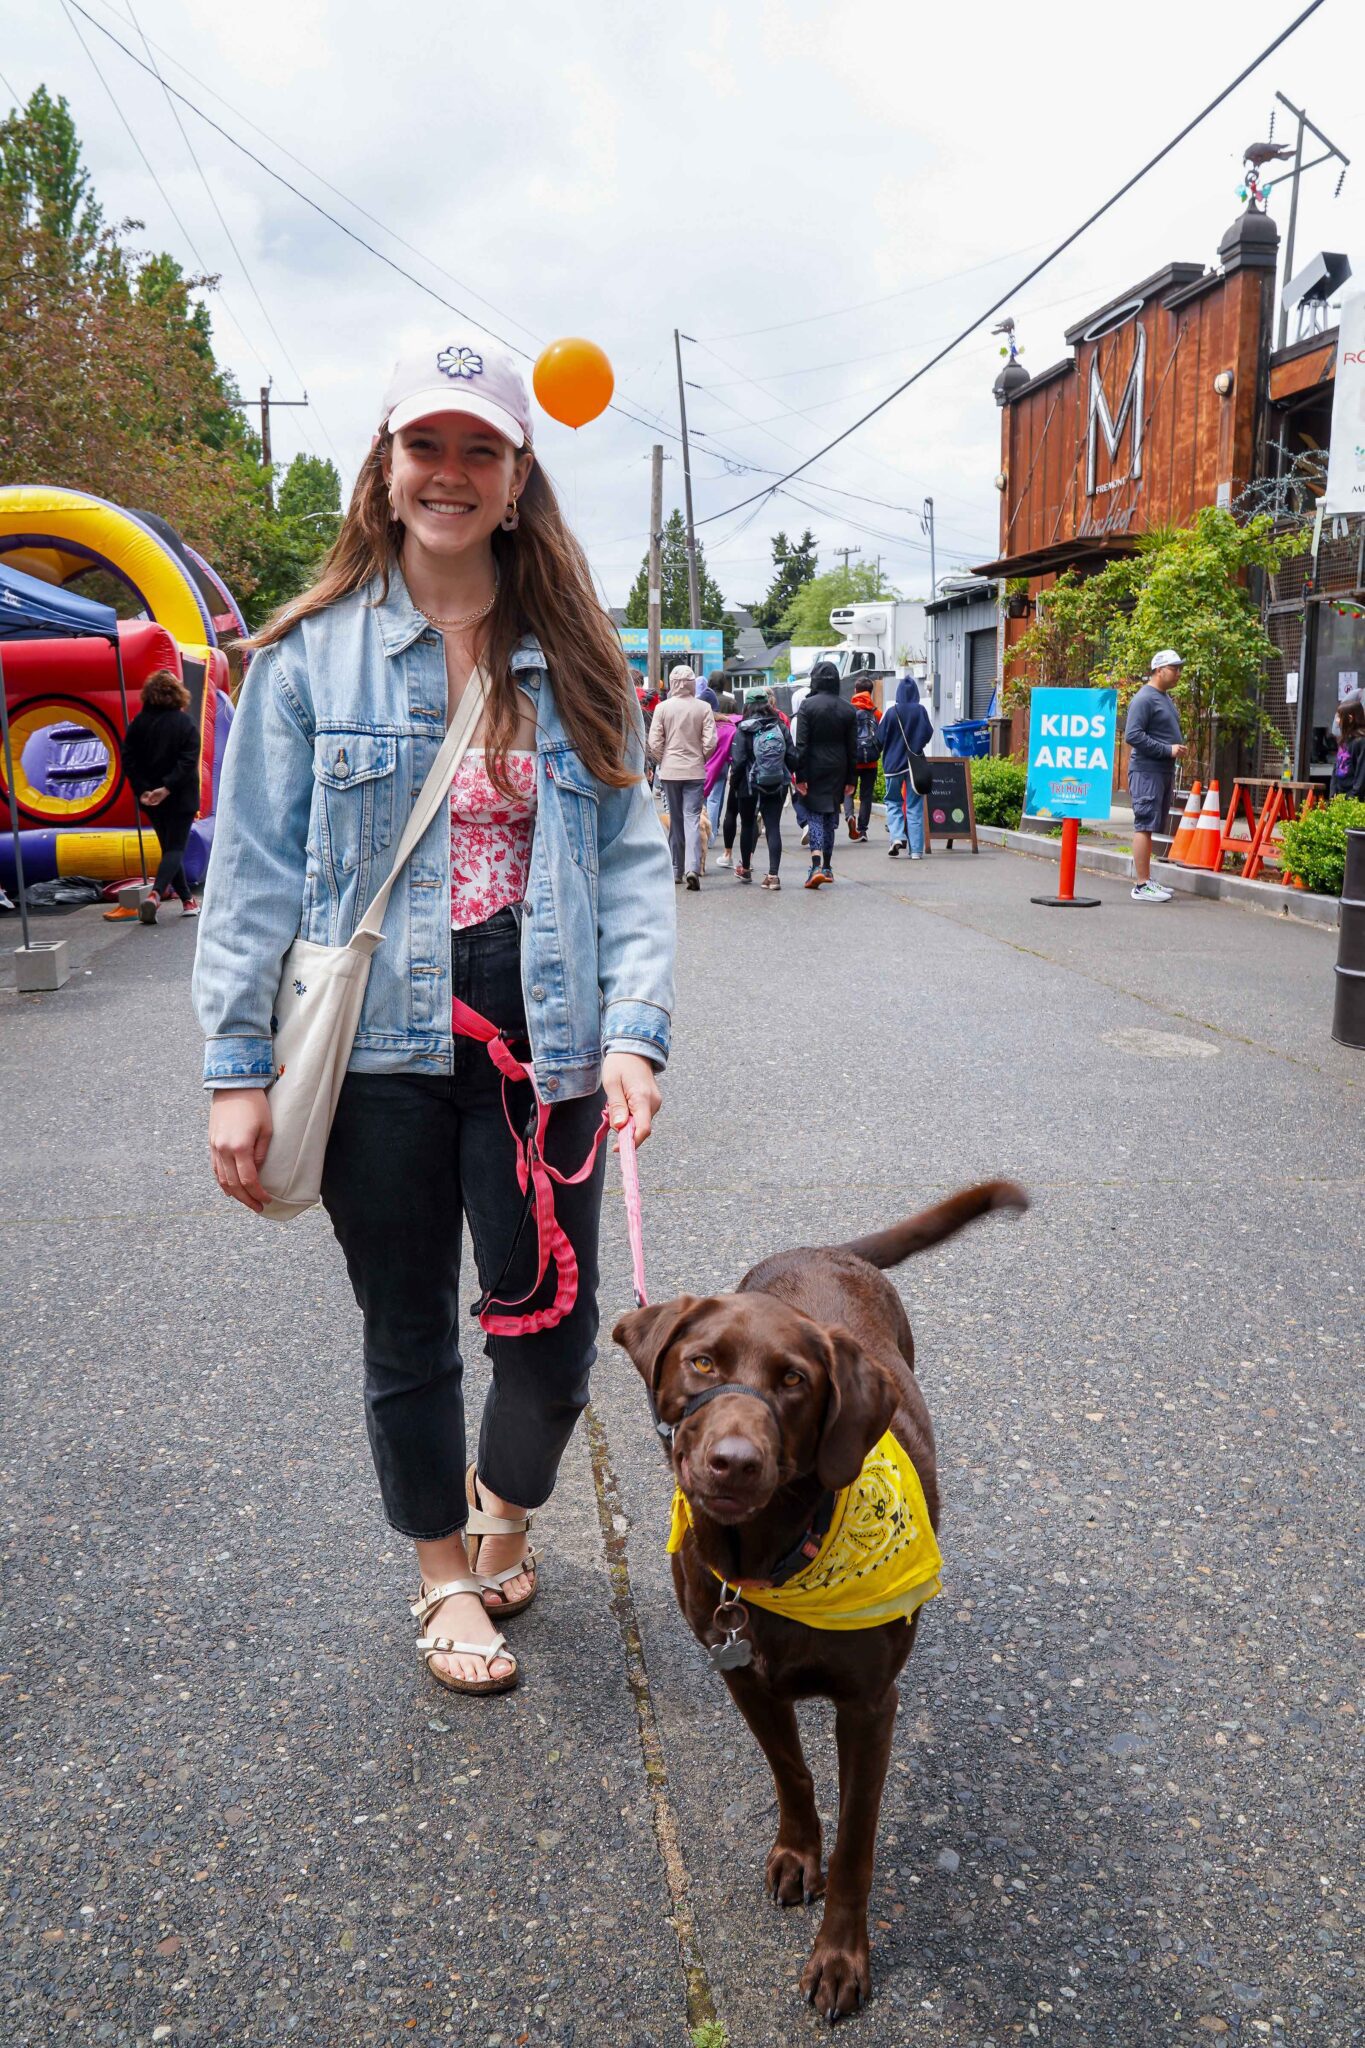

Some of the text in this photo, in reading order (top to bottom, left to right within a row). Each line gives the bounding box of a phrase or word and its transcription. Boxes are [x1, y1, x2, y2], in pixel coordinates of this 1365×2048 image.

[1095, 477, 1126, 494] FREMONT
[659, 634, 691, 646] LOHA
[1040, 714, 1106, 738] KIDS
[1034, 746, 1109, 770] AREA
